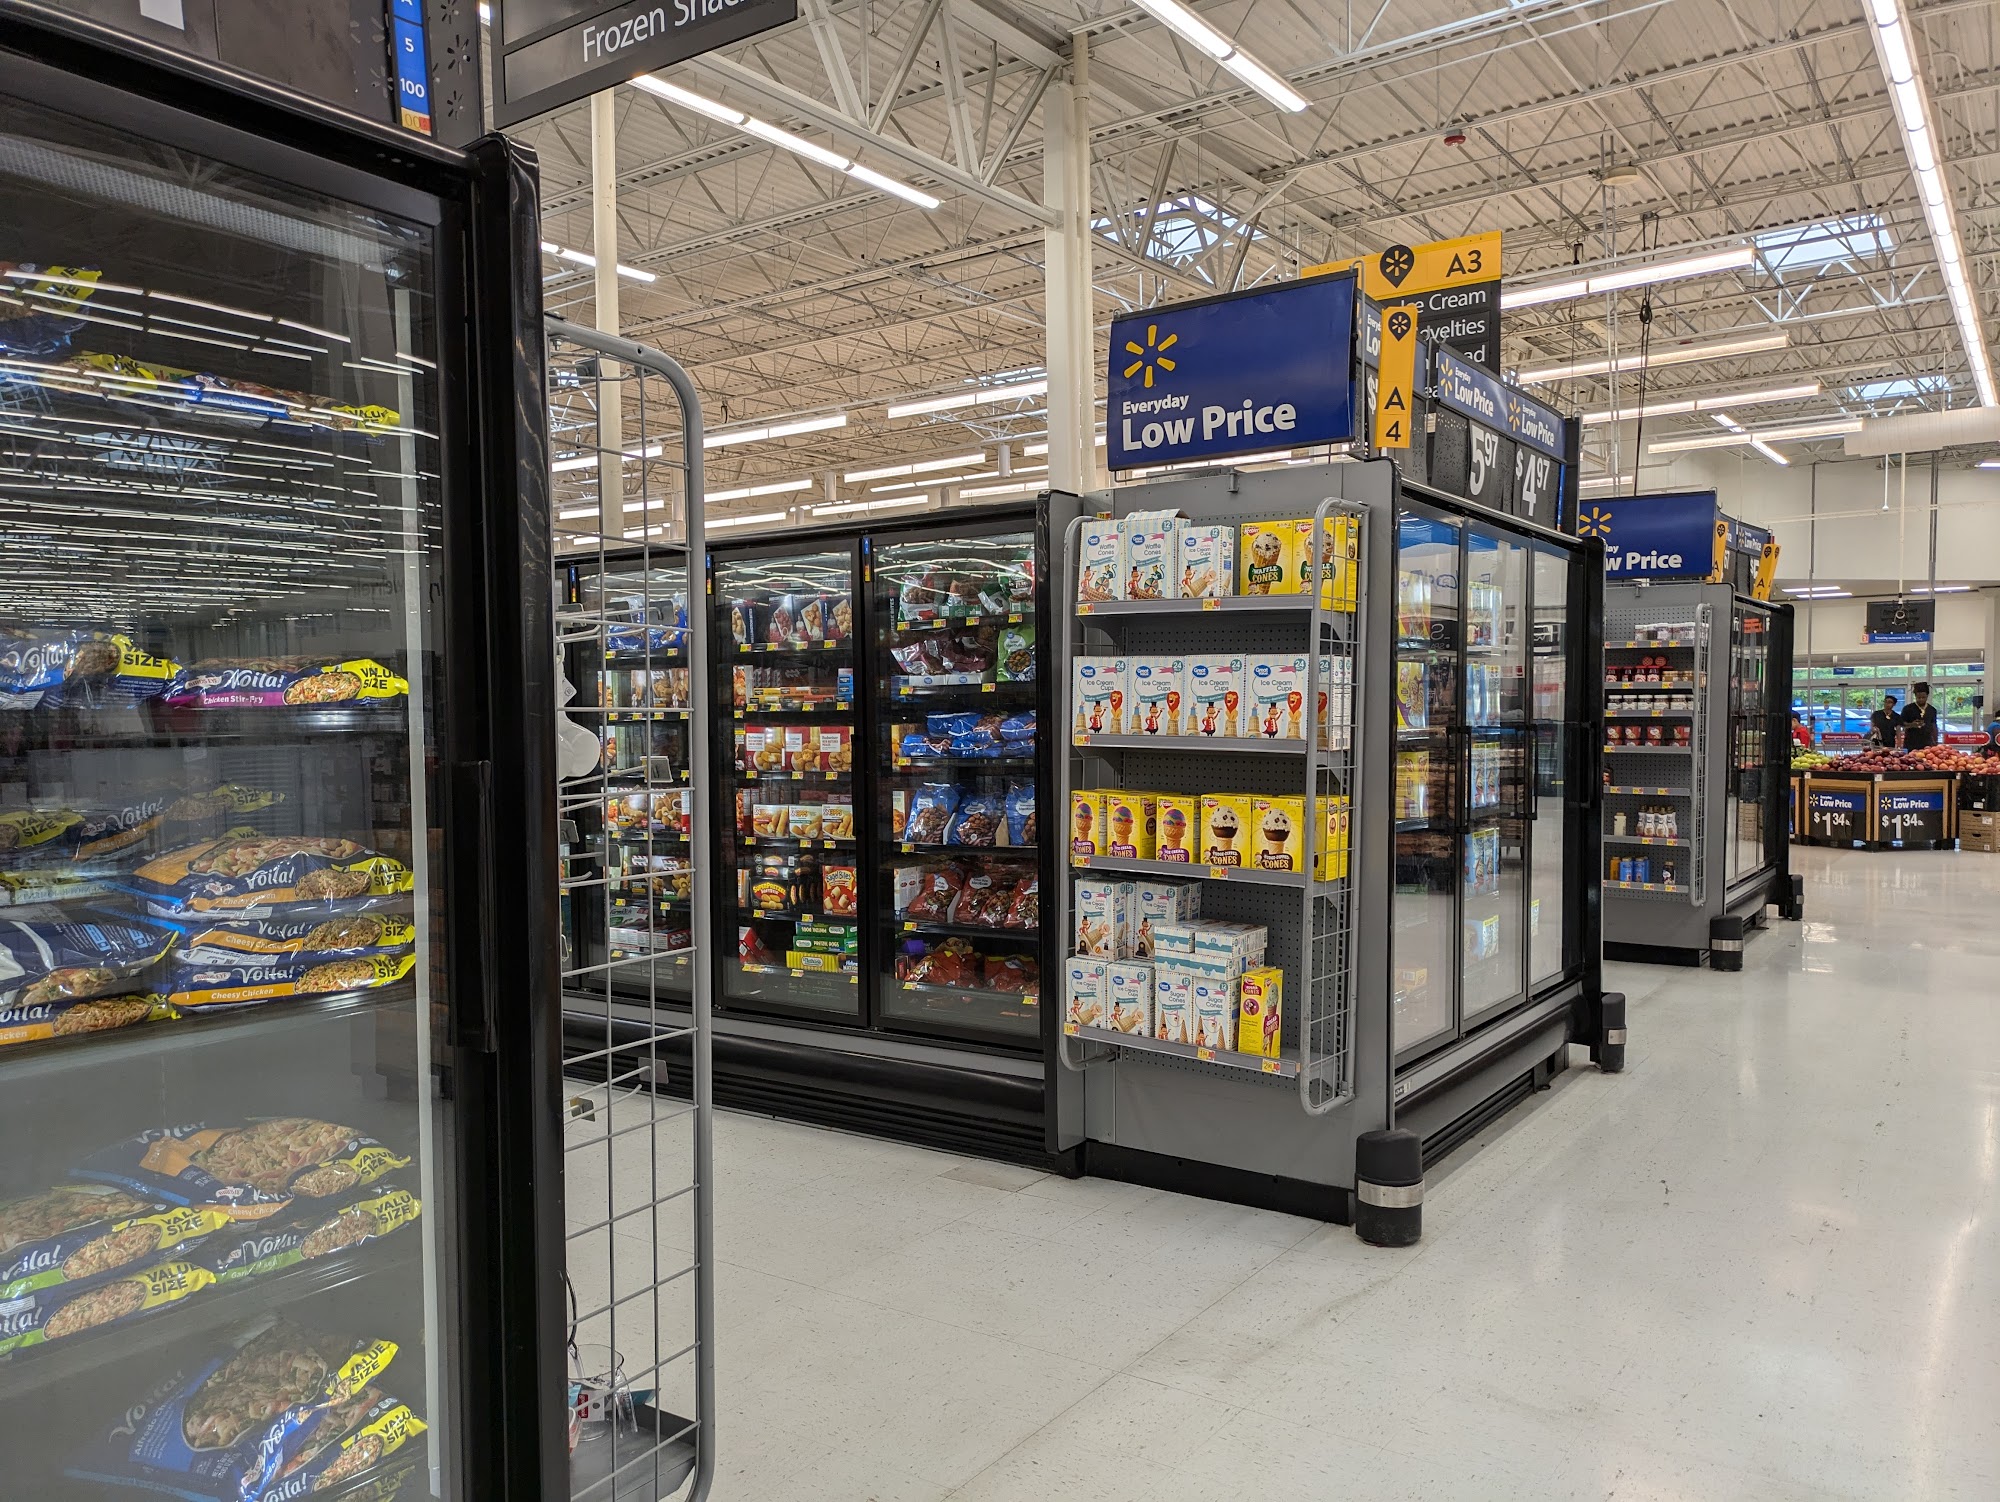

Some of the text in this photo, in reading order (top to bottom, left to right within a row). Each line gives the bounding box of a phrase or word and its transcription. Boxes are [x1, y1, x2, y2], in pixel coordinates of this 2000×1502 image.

[583, 0, 744, 62] Frozen Sna
[405, 37, 414, 53] 5
[400, 78, 425, 98] 100
[1446, 250, 1482, 277] A3
[1429, 290, 1486, 311] Cream
[1420, 319, 1485, 341] ovelties
[1455, 367, 1471, 384] Everyday
[1122, 393, 1189, 416] Everyday
[1384, 386, 1405, 410] A
[1454, 377, 1494, 418] Low Price
[1522, 404, 1537, 419] Everyday
[1122, 400, 1296, 452] Low Price
[1385, 420, 1401, 442] 4
[1521, 414, 1555, 447] Low Price
[1626, 550, 1683, 570] Price
[1252, 572, 1279, 582] CONES
[1253, 565, 1279, 574] WAFFLE
[1756, 578, 1765, 588] A
[123, 654, 163, 667] SIZE
[362, 679, 388, 689] SIZE
[203, 695, 229, 705] Chicken
[1820, 799, 1852, 809] Low Price
[1893, 800, 1929, 809] Low Price
[22, 819, 58, 838] SIZE
[1164, 854, 1185, 862] CONES
[1212, 856, 1238, 865] CONES
[1264, 859, 1289, 868] CONES
[246, 867, 295, 889] Voila!
[374, 873, 402, 886] SIZE
[385, 925, 405, 936] SIZ
[225, 935, 254, 948] Cheesy
[232, 966, 294, 984] Voila!
[211, 988, 274, 1000] Cheesy Chicken
[1207, 996, 1223, 1004] Sugar
[0, 1004, 52, 1022] oila!
[0, 1031, 27, 1040] icken
[361, 1159, 386, 1176] SIZE
[228, 1206, 252, 1216] Cheesy
[374, 1193, 411, 1214] VALU
[379, 1204, 411, 1225] SIZE
[166, 1215, 204, 1236] SIZE
[151, 1277, 188, 1296] SIZE
[0, 1306, 43, 1334] ila!
[347, 1342, 386, 1377] VALUE
[351, 1360, 380, 1385] SIZE
[134, 1412, 157, 1456] Alfredo
